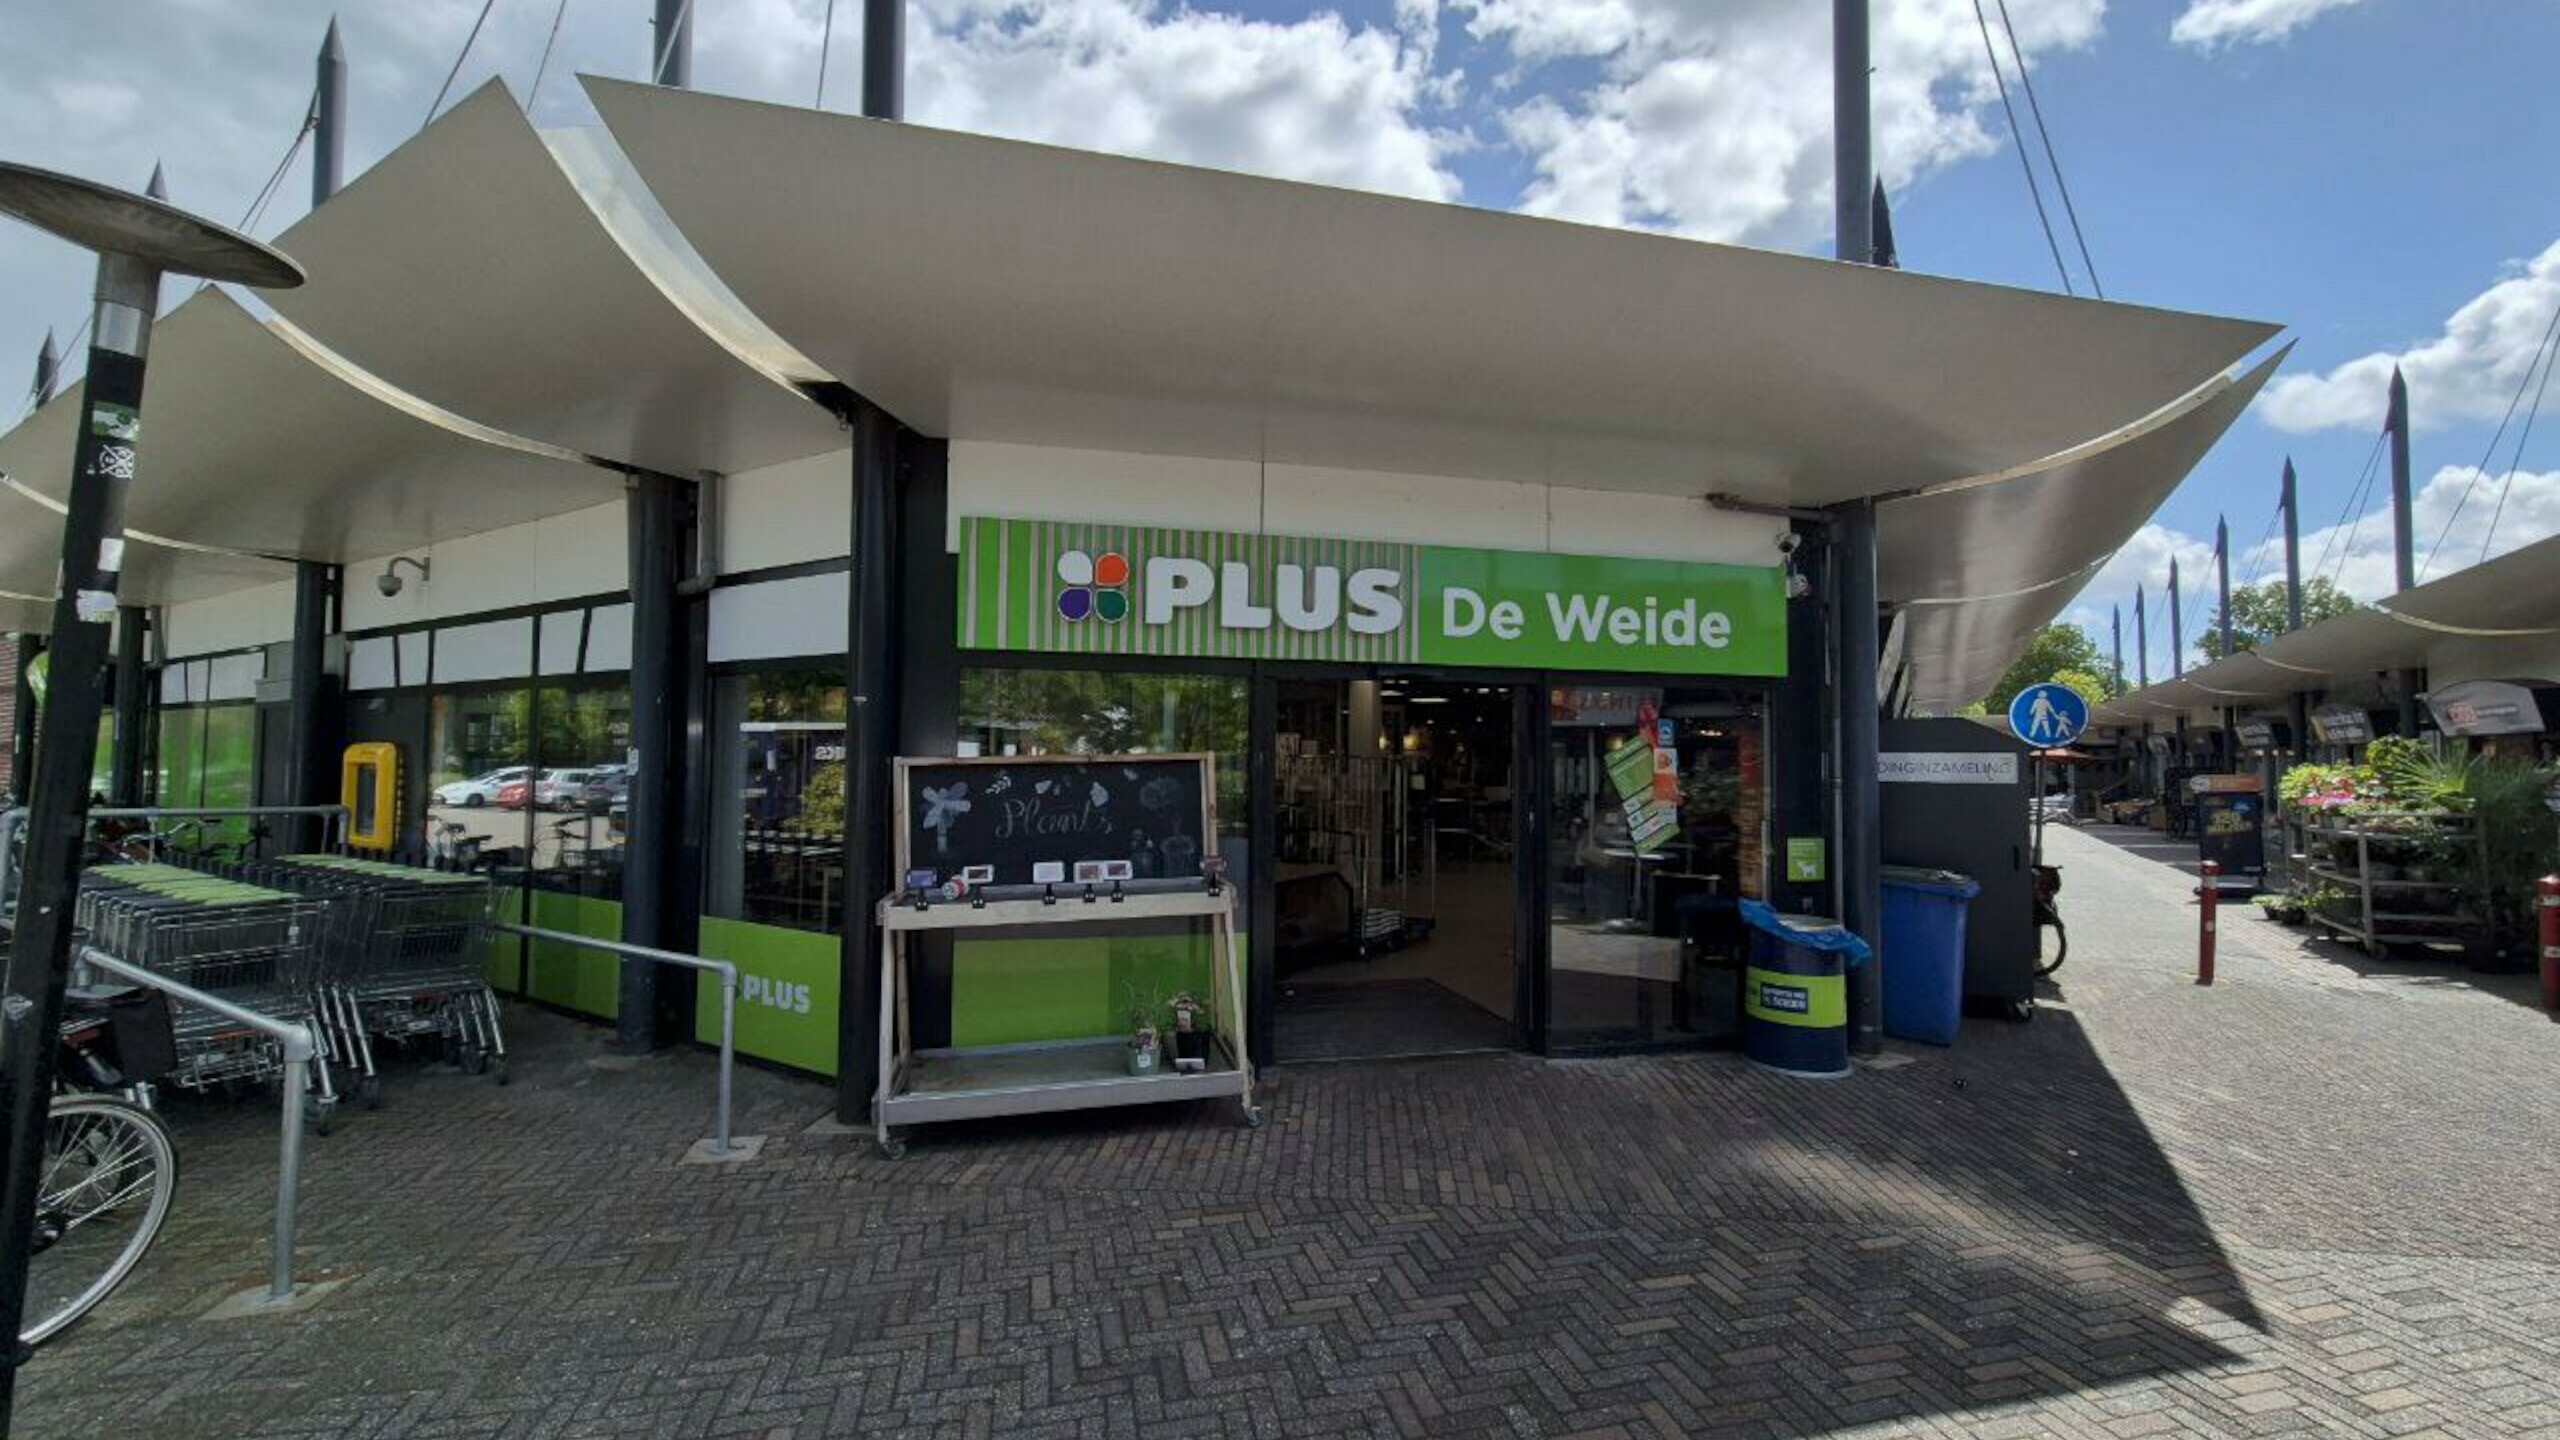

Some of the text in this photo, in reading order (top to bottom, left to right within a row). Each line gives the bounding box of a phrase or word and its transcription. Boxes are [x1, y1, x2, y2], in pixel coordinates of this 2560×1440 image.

[1145, 556, 1402, 635] PLUS
[1442, 587, 1732, 649] De Weide
[995, 798, 1113, 838] Plants
[743, 974, 810, 1014] PLUS
